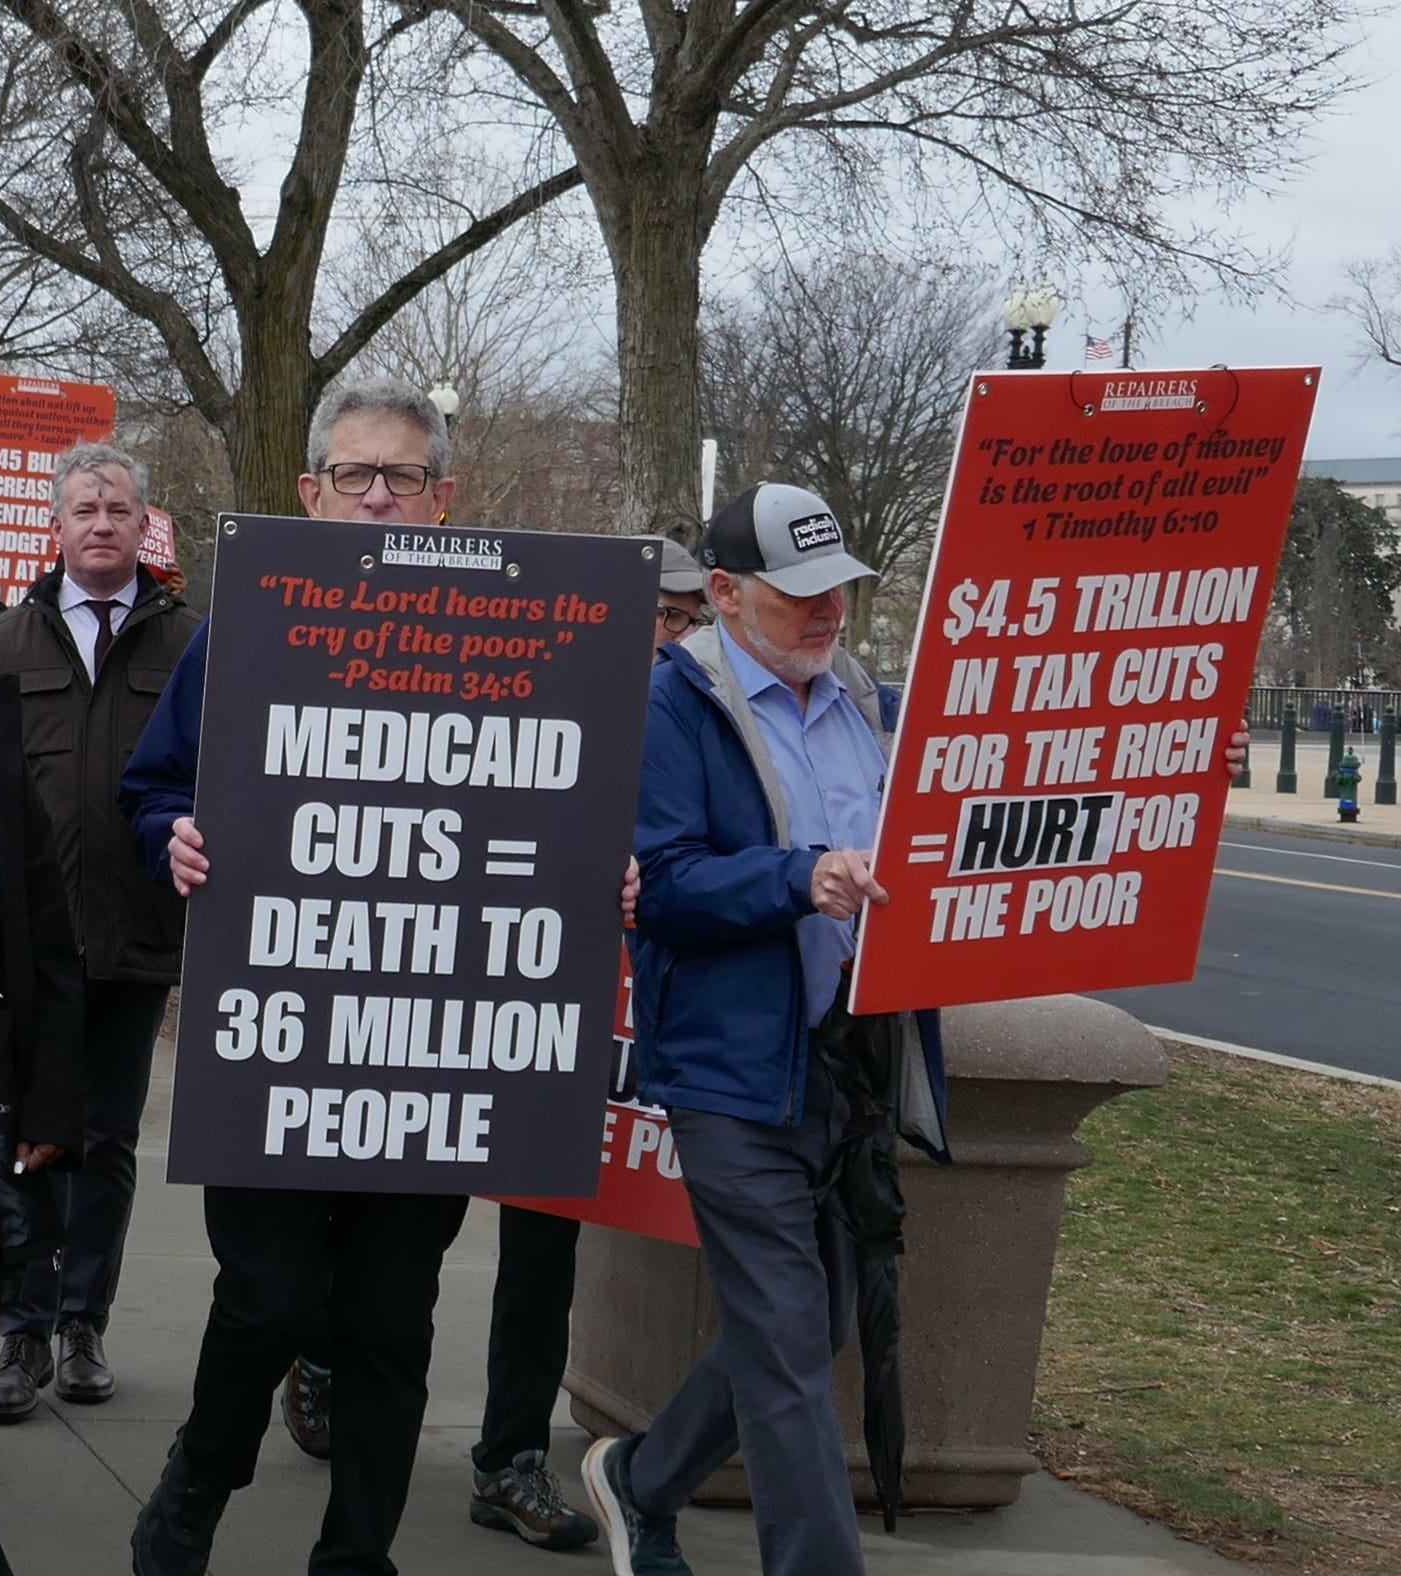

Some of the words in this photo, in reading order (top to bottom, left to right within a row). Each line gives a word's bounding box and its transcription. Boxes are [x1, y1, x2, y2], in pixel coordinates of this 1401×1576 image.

[1104, 379, 1198, 397] REPAIRERS
[979, 438, 1044, 467] “For
[1048, 438, 1091, 466] the
[1098, 436, 1160, 465] love
[1162, 432, 1198, 468] of
[1198, 436, 1286, 464] money
[979, 476, 1006, 505] is
[1011, 474, 1056, 504] the
[1062, 472, 1121, 502] root
[1127, 466, 1158, 505] of
[1162, 471, 1199, 498] all
[1203, 466, 1270, 497] evil”
[384, 533, 503, 556] REPAIRERS
[1022, 518, 1038, 541] 1
[1045, 509, 1157, 543] Timothy
[1162, 508, 1219, 535] 6:10
[15, 559, 39, 582] AT
[384, 551, 401, 561] OF
[408, 553, 434, 564] THE
[448, 556, 500, 568] BREACH
[259, 575, 344, 609] “The
[350, 580, 441, 616] Lord
[445, 587, 545, 622] hears
[553, 593, 609, 625] the
[942, 576, 1061, 646] $4.5
[1073, 566, 1260, 634] TRILLION
[287, 624, 345, 655] cry
[353, 621, 398, 658] of
[398, 624, 453, 656] the
[459, 631, 575, 664] poor.”
[328, 659, 454, 694] -Psalm
[460, 669, 535, 702] 34:6
[943, 657, 999, 717] IN
[1010, 651, 1101, 713] TAX
[1108, 642, 1225, 708] CUTS
[263, 703, 583, 791] MEDICAID
[916, 733, 1010, 794] FOR
[1023, 726, 1106, 788] THE
[1111, 716, 1220, 781] RICH
[290, 802, 464, 882] CUTS
[485, 839, 538, 877] =
[907, 833, 949, 864] =
[959, 795, 1115, 872] HURT
[1115, 792, 1201, 854] FOR
[248, 895, 460, 976] DEATH
[481, 906, 563, 980] TO
[929, 882, 1013, 943] THE
[1020, 871, 1143, 935] POOR
[215, 987, 306, 1063] 36
[327, 994, 581, 1073] MILLION
[264, 1085, 494, 1163] PEOPLE
[626, 1118, 683, 1180] PO
